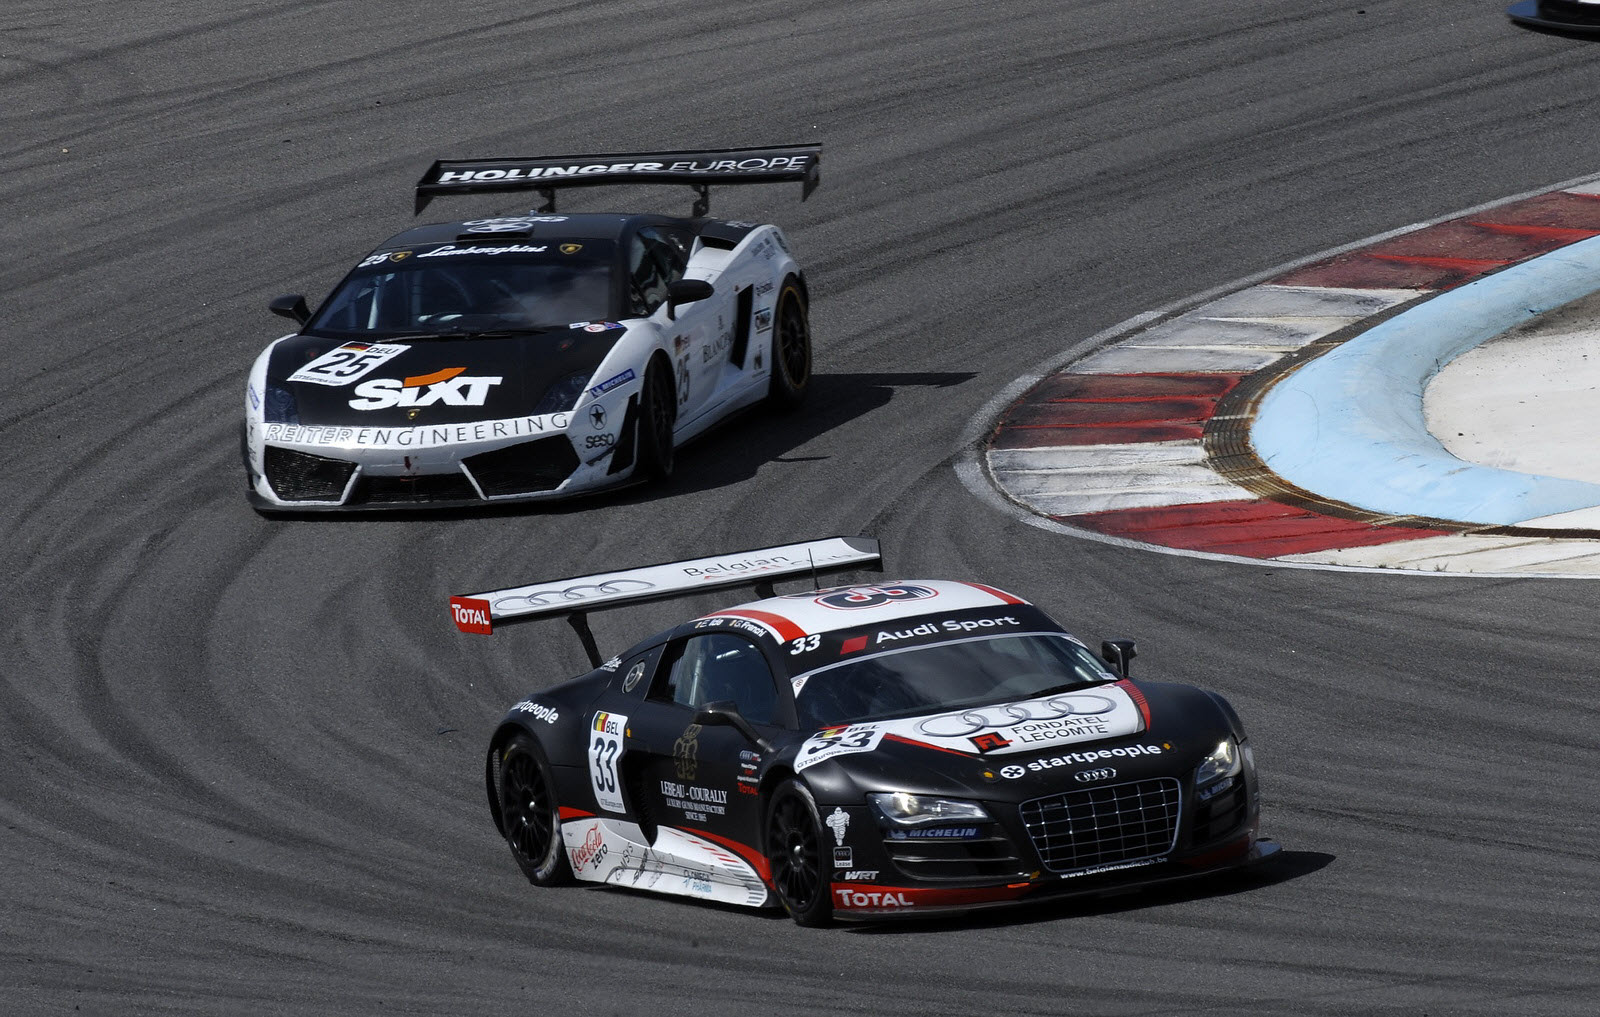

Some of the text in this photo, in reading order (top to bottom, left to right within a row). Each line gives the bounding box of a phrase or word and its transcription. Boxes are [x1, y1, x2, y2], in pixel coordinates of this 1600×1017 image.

[438, 155, 809, 184] HOLINGER EUROPE
[358, 252, 391, 268] 25
[417, 245, 548, 258] Lamborghini
[366, 347, 399, 355] DEU
[306, 352, 383, 377] 25
[264, 412, 568, 446] REITER ENGINEERING
[683, 555, 790, 577] Belgian
[452, 603, 490, 625] TOTAL
[875, 615, 1021, 645] Audi Sport
[790, 633, 821, 656] 33
[605, 720, 619, 736] BEL
[847, 724, 880, 733] BEL
[1011, 715, 1110, 735] FONDATEL
[1018, 724, 1109, 744] LECOMTE
[807, 730, 876, 755] 33
[593, 737, 618, 793] 33
[1027, 743, 1162, 772] startpeople
[660, 780, 685, 798] LEBEAU
[689, 786, 728, 804] COURALLY
[909, 827, 977, 838] MICHELIN
[590, 843, 608, 870] zero
[844, 870, 880, 881] WRT
[836, 889, 914, 907] TOTAL
